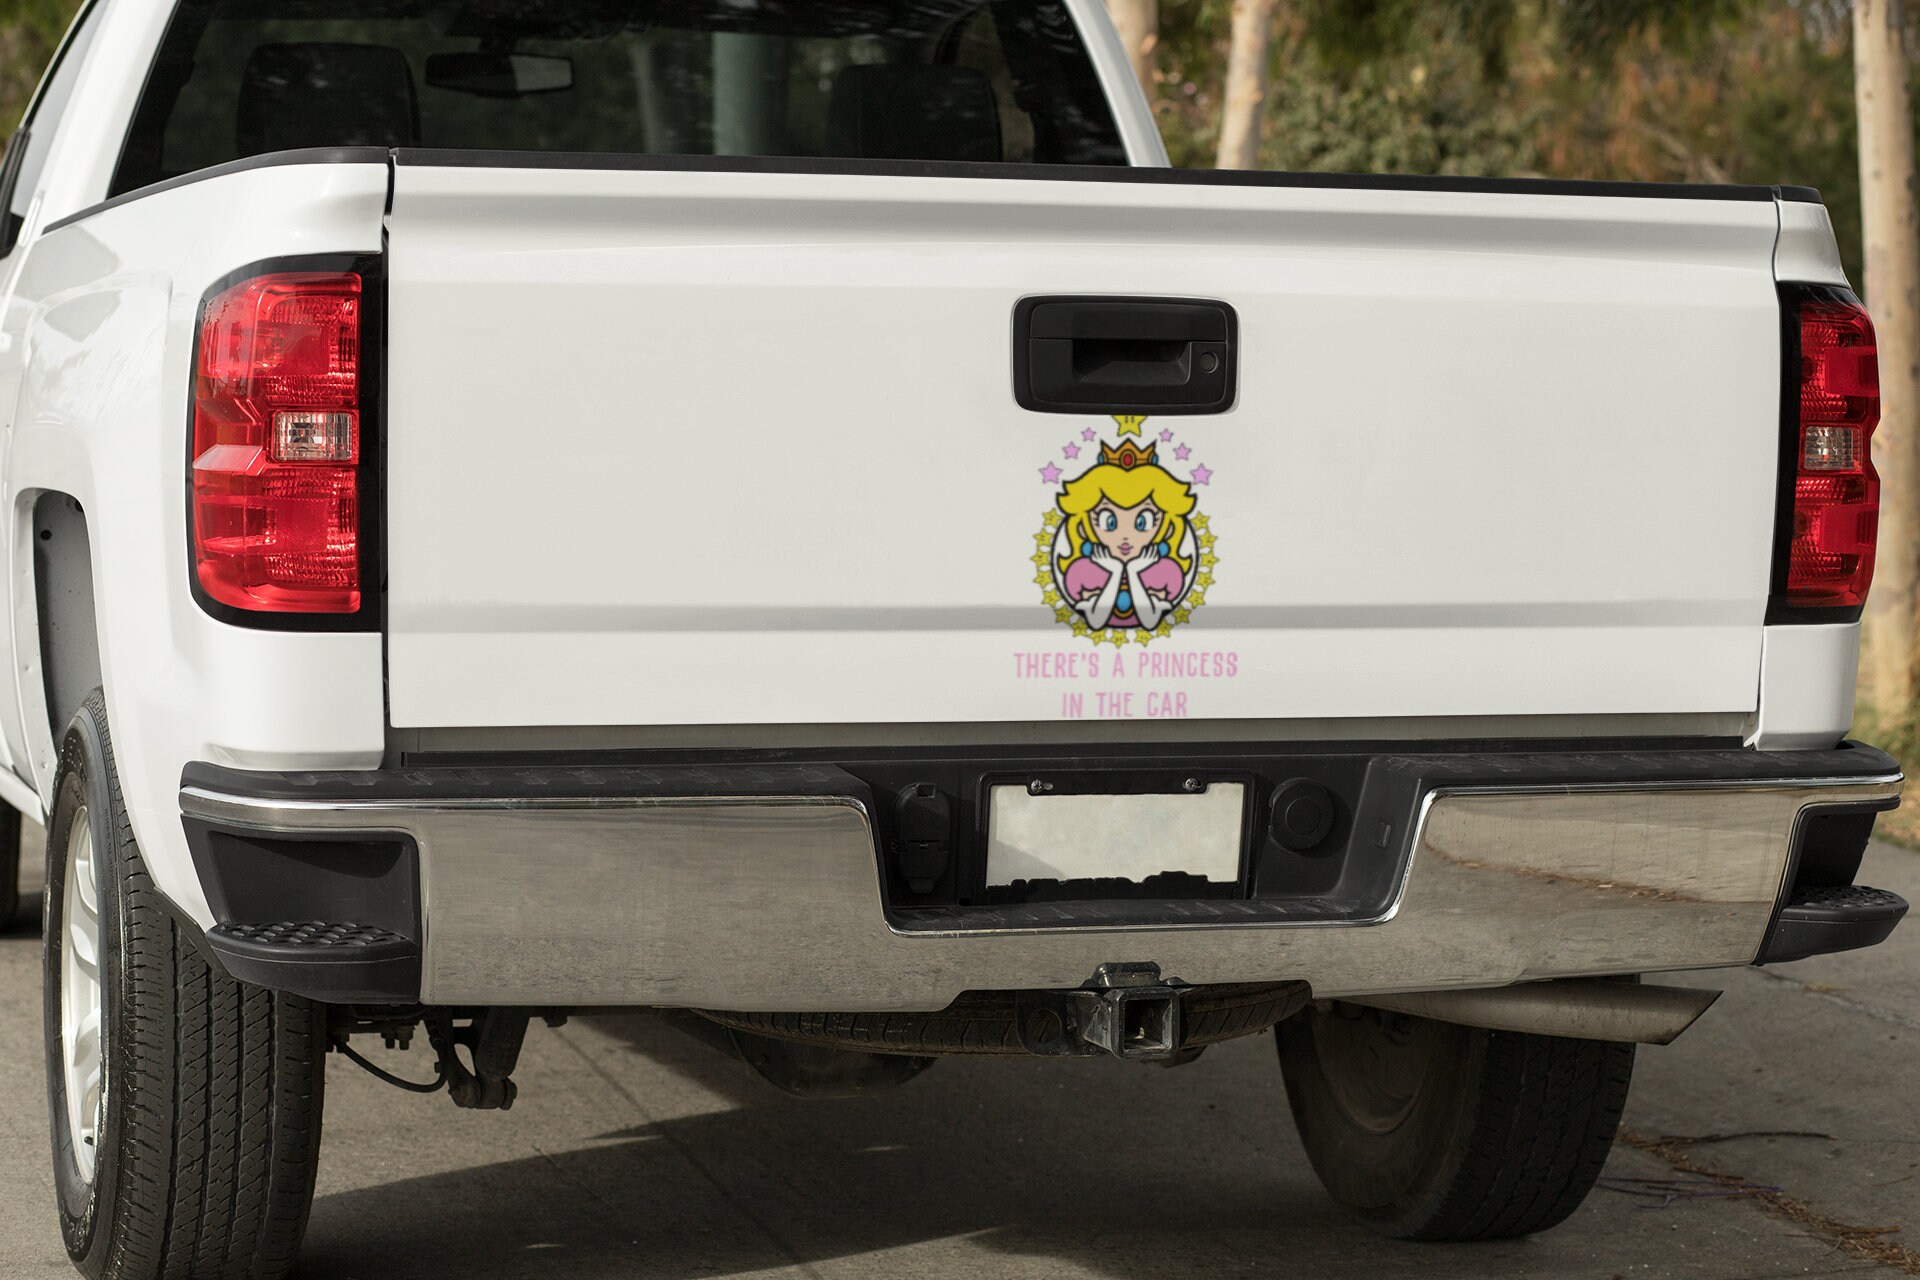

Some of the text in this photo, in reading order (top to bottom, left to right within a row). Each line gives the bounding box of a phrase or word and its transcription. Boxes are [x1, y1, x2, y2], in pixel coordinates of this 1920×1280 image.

[1013, 651, 1239, 679] THERE'S A PRINCESS
[1062, 690, 1188, 719] IN THE CAR
